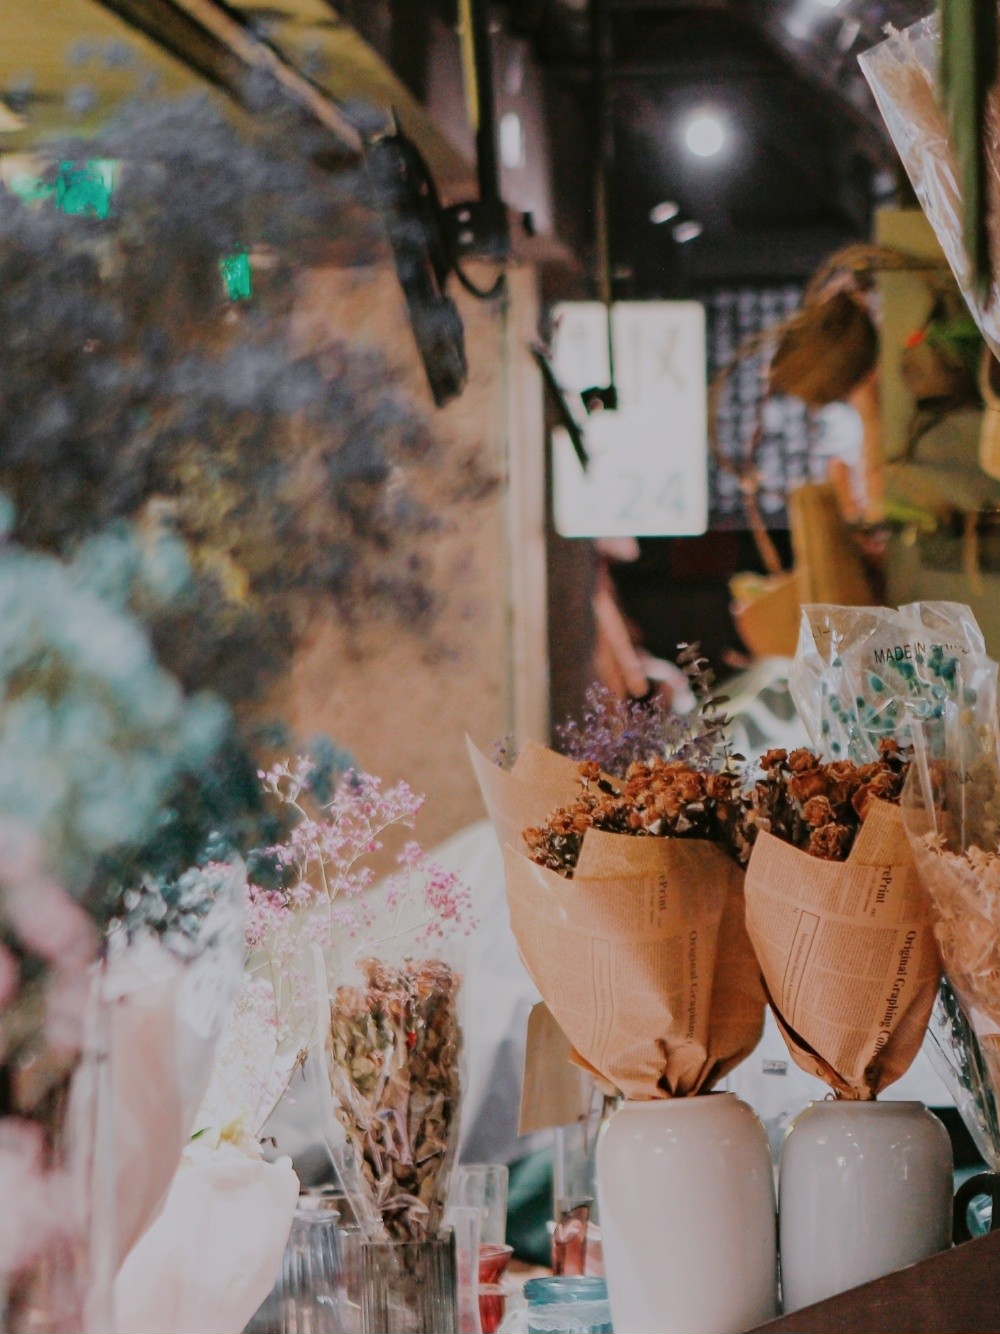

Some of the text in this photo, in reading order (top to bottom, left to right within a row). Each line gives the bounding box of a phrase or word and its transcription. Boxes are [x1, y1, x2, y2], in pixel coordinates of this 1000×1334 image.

[874, 645, 912, 663] MADE
[897, 930, 917, 977] Original
[879, 976, 907, 1028] Graphing
